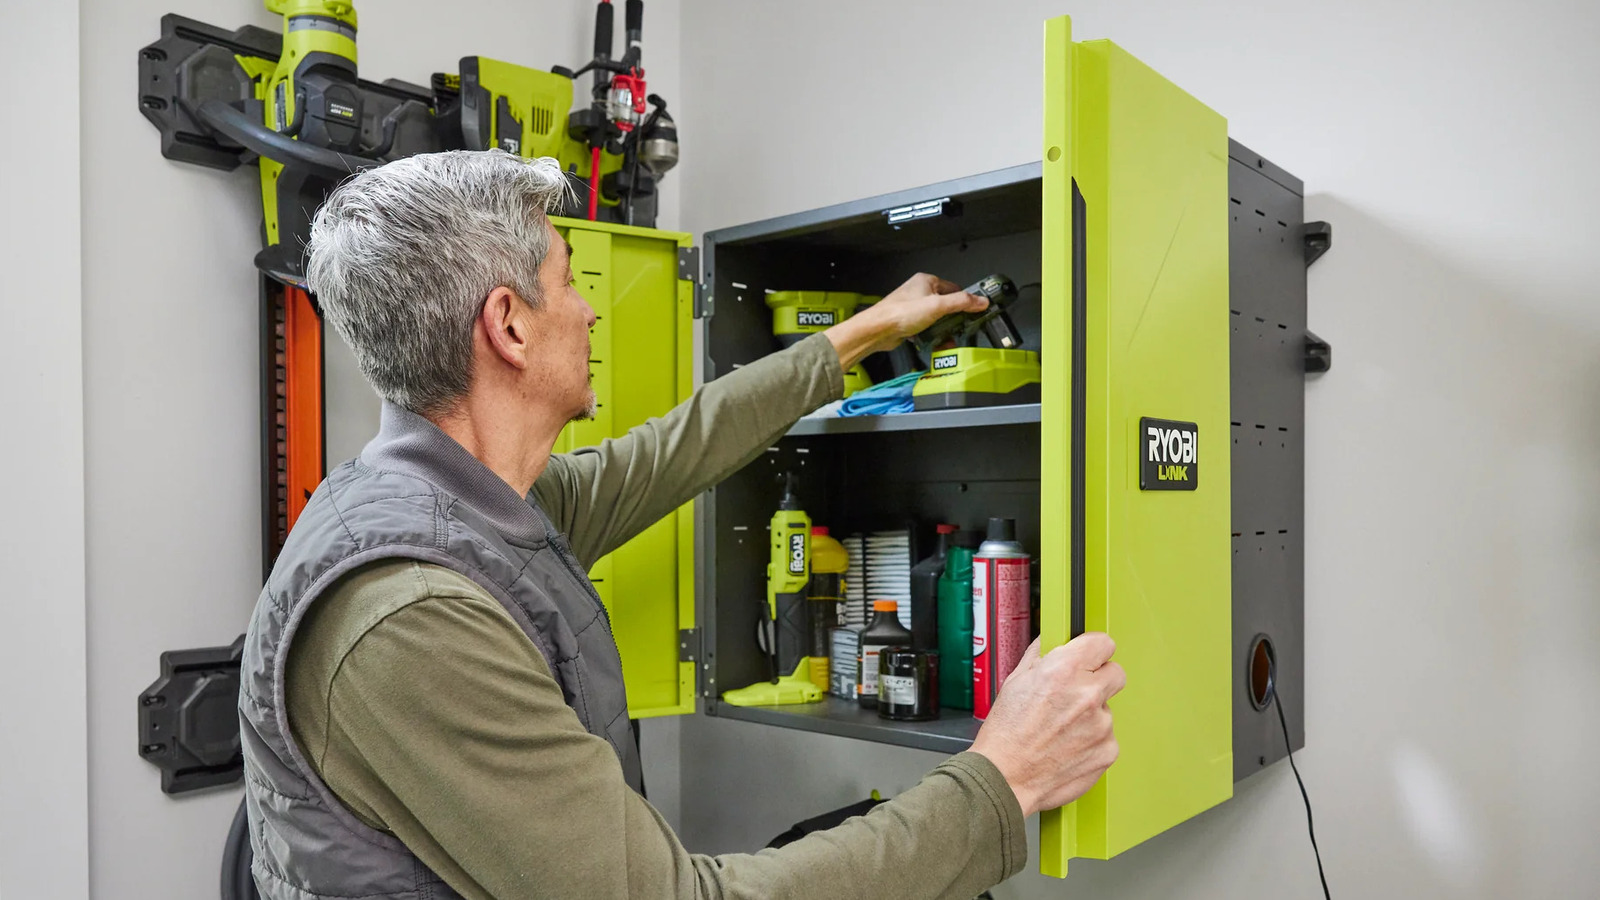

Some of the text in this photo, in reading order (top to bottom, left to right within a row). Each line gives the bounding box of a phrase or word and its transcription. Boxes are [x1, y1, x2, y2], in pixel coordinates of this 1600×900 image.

[798, 312, 834, 325] RYOBI
[934, 355, 957, 369] RYOBI
[1147, 426, 1197, 464] RYOBI
[791, 534, 804, 572] RYOBI
